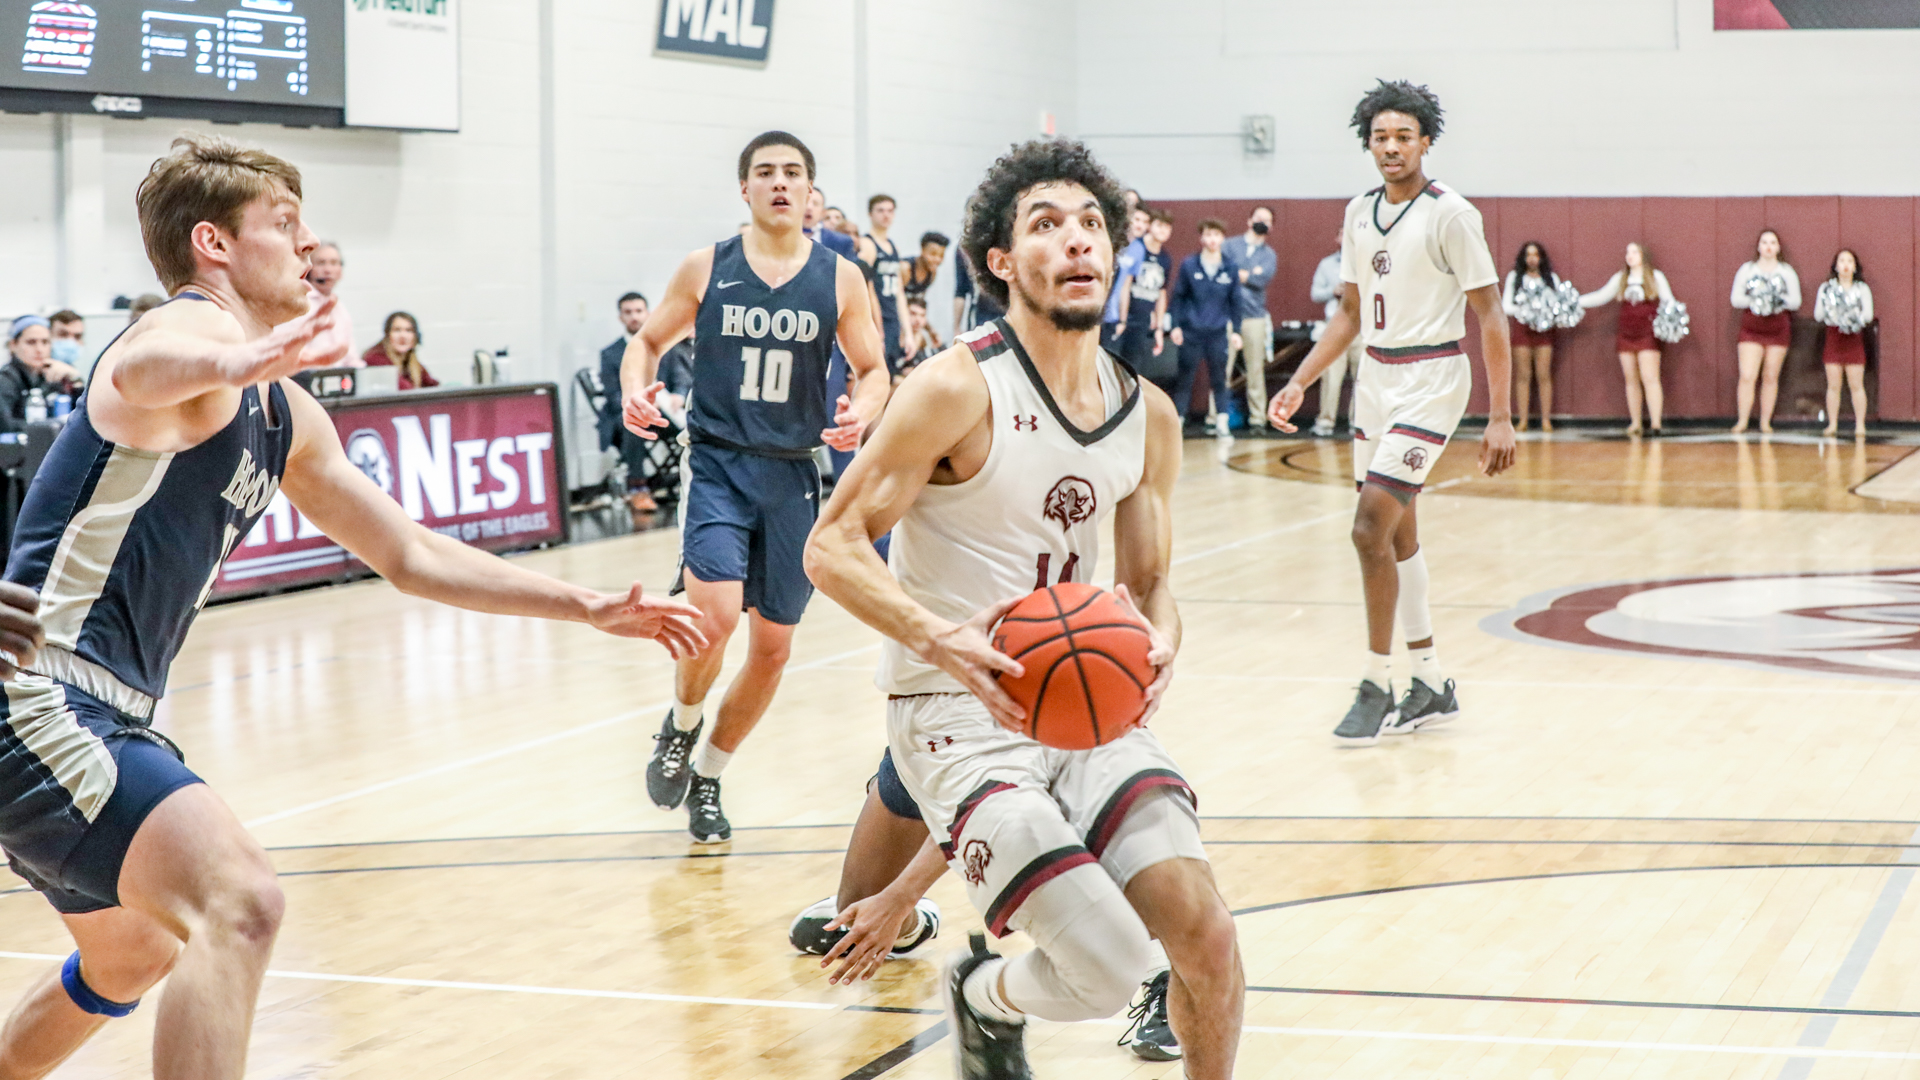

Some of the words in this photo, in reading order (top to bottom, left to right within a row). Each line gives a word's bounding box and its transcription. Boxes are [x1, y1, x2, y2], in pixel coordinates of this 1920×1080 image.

[721, 304, 819, 342] HOOD
[1374, 293, 1386, 330] 0
[739, 346, 793, 403] 10
[504, 511, 549, 535] EAGLES
